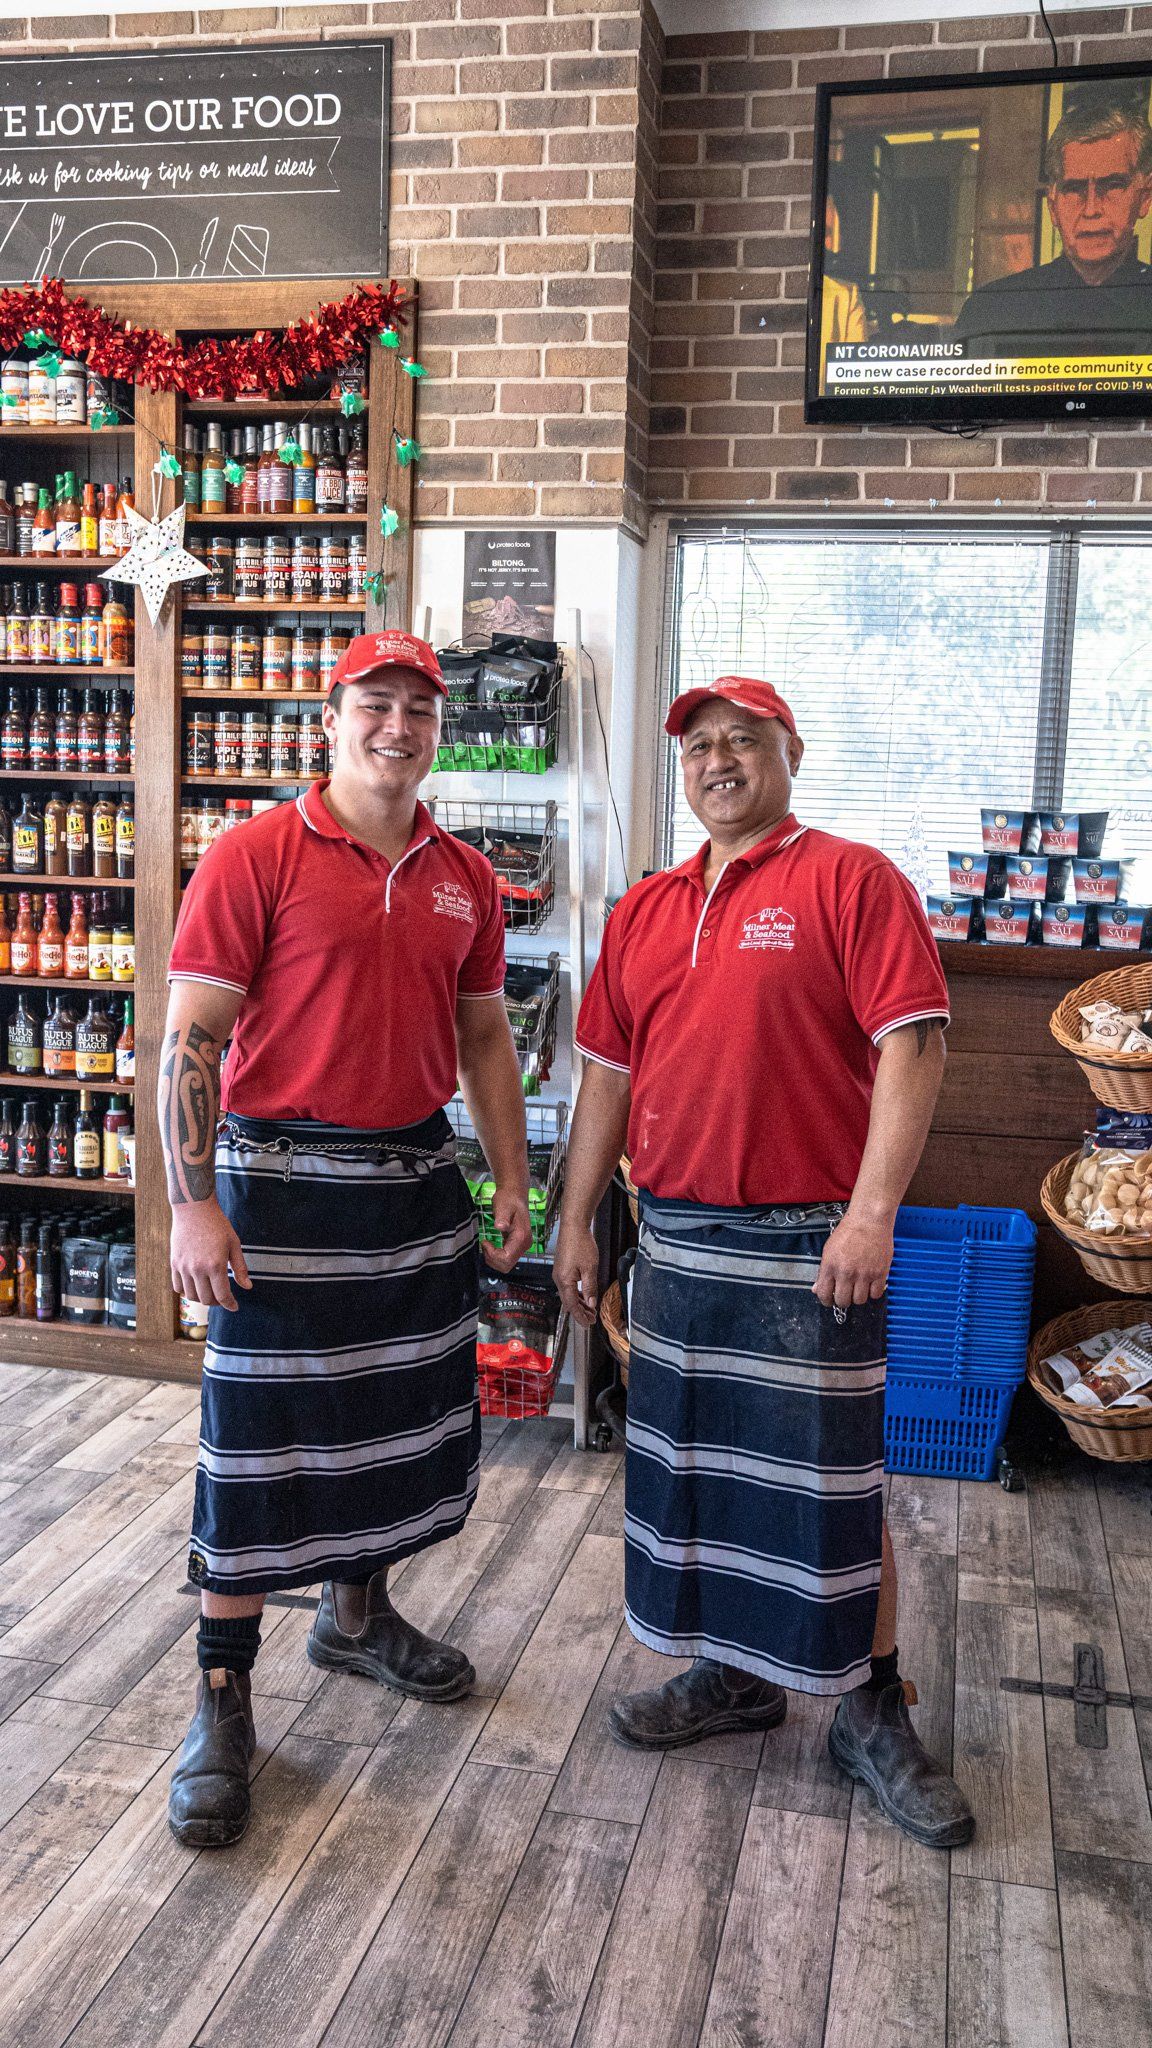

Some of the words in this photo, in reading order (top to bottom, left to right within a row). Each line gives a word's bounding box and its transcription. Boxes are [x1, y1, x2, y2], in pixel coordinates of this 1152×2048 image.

[0, 105, 27, 137] E
[35, 102, 135, 137] LOVE
[144, 98, 223, 132] OUR
[232, 93, 342, 130] FOOD
[28, 167, 48, 186] us
[54, 161, 81, 192] for
[86, 158, 153, 191] cooking
[158, 157, 194, 189] tips
[199, 161, 221, 178] or
[227, 155, 268, 178] meal
[274, 155, 317, 177] ideas
[835, 346, 854, 359] NT
[857, 344, 963, 358] CORONAVIRUS
[836, 366, 861, 378] One
[864, 367, 893, 378] new
[896, 367, 927, 377] case
[930, 363, 992, 377] recorded
[995, 363, 1007, 375] in
[1011, 364, 1060, 375] remote
[1064, 361, 1143, 375] community
[834, 386, 869, 396] Former
[873, 386, 886, 395] SA
[889, 385, 928, 395] Premier
[931, 385, 946, 396] Jay
[949, 383, 1002, 394] Weatherill
[1005, 383, 1031, 393] tests
[1033, 382, 1076, 393] positive
[1078, 381, 1093, 392] for
[492, 559, 526, 567] BILTONG.
[263, 571, 290, 580] APPLE
[243, 580, 257, 588] RUB
[266, 580, 285, 588] RUB
[294, 579, 311, 587] RUB
[323, 580, 342, 588] RUB
[215, 746, 240, 755] APPLE
[217, 754, 236, 763] RUB
[990, 833, 1010, 844] SALT
[1049, 836, 1068, 846] SALT
[957, 876, 975, 887] SALT
[1016, 880, 1036, 891] SALT
[1084, 883, 1106, 894] SALT
[742, 923, 771, 931] Milner
[772, 922, 795, 931] Meat
[937, 920, 957, 930] SALT
[995, 923, 1017, 935] SALT
[745, 931, 751, 939] &
[752, 930, 790, 939] Seafood
[1051, 926, 1073, 937] SALT
[1108, 928, 1130, 939] SALT
[8, 1026, 33, 1037] RUFUS
[44, 1030, 73, 1040] RUFUS
[9, 1035, 33, 1043] TEAGUE
[44, 1039, 73, 1047] TEAGUE
[78, 1033, 108, 1043] RUFUS
[78, 1041, 107, 1050] TEAGUE
